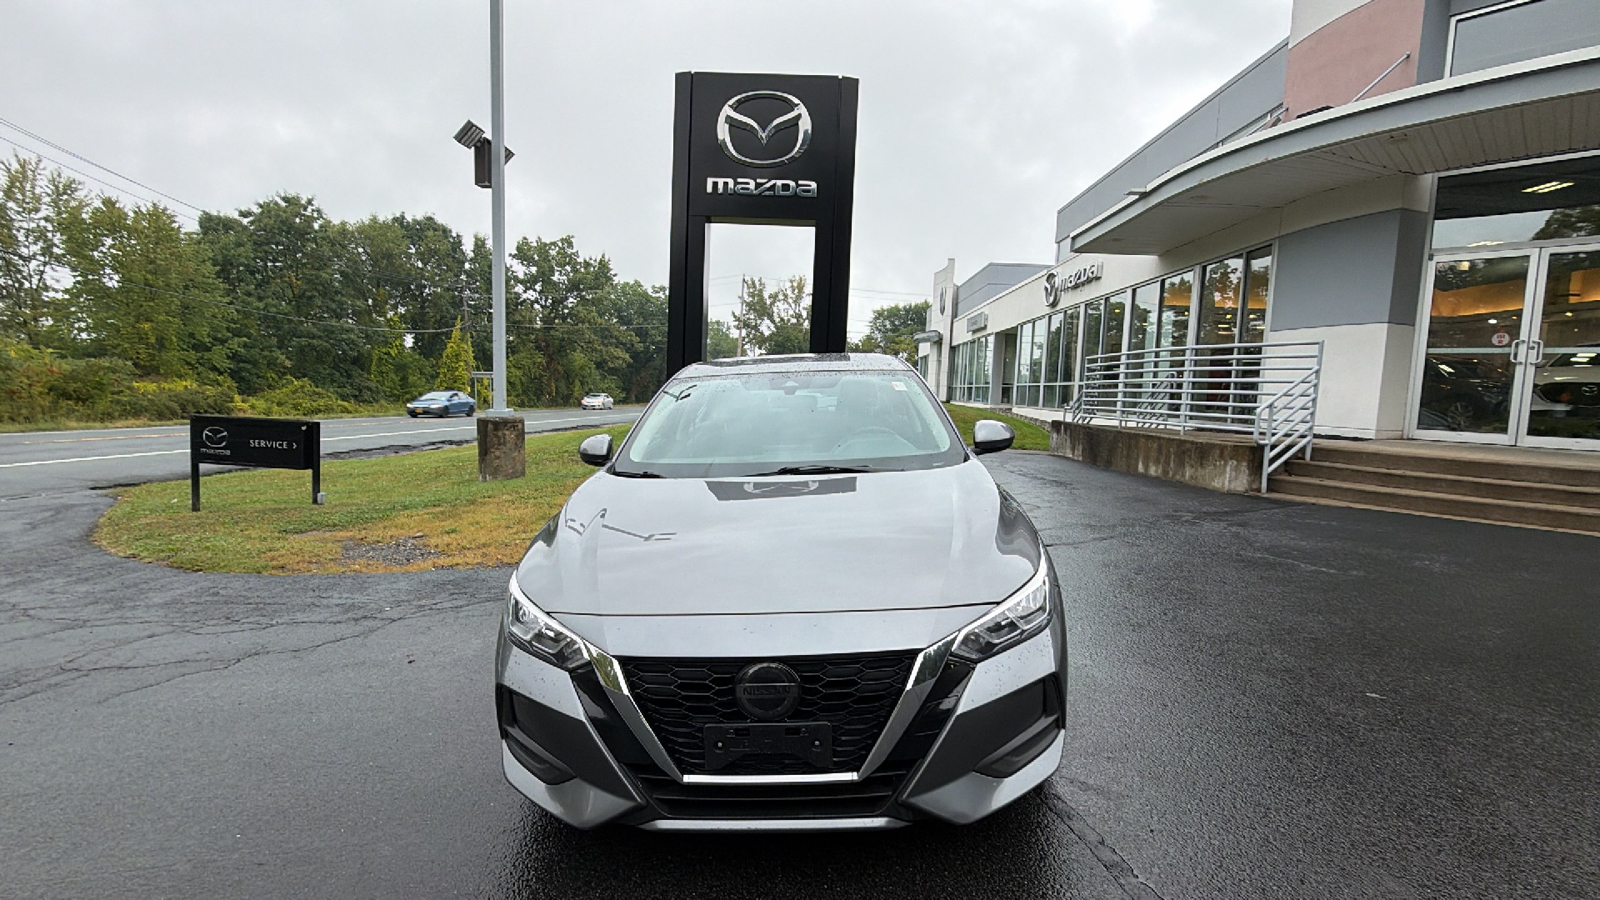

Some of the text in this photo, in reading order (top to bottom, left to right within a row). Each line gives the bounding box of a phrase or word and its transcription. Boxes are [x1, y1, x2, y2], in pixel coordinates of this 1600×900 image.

[706, 177, 818, 198] mazda
[249, 440, 288, 449] SERVICE
[742, 686, 791, 696] NISSAN
